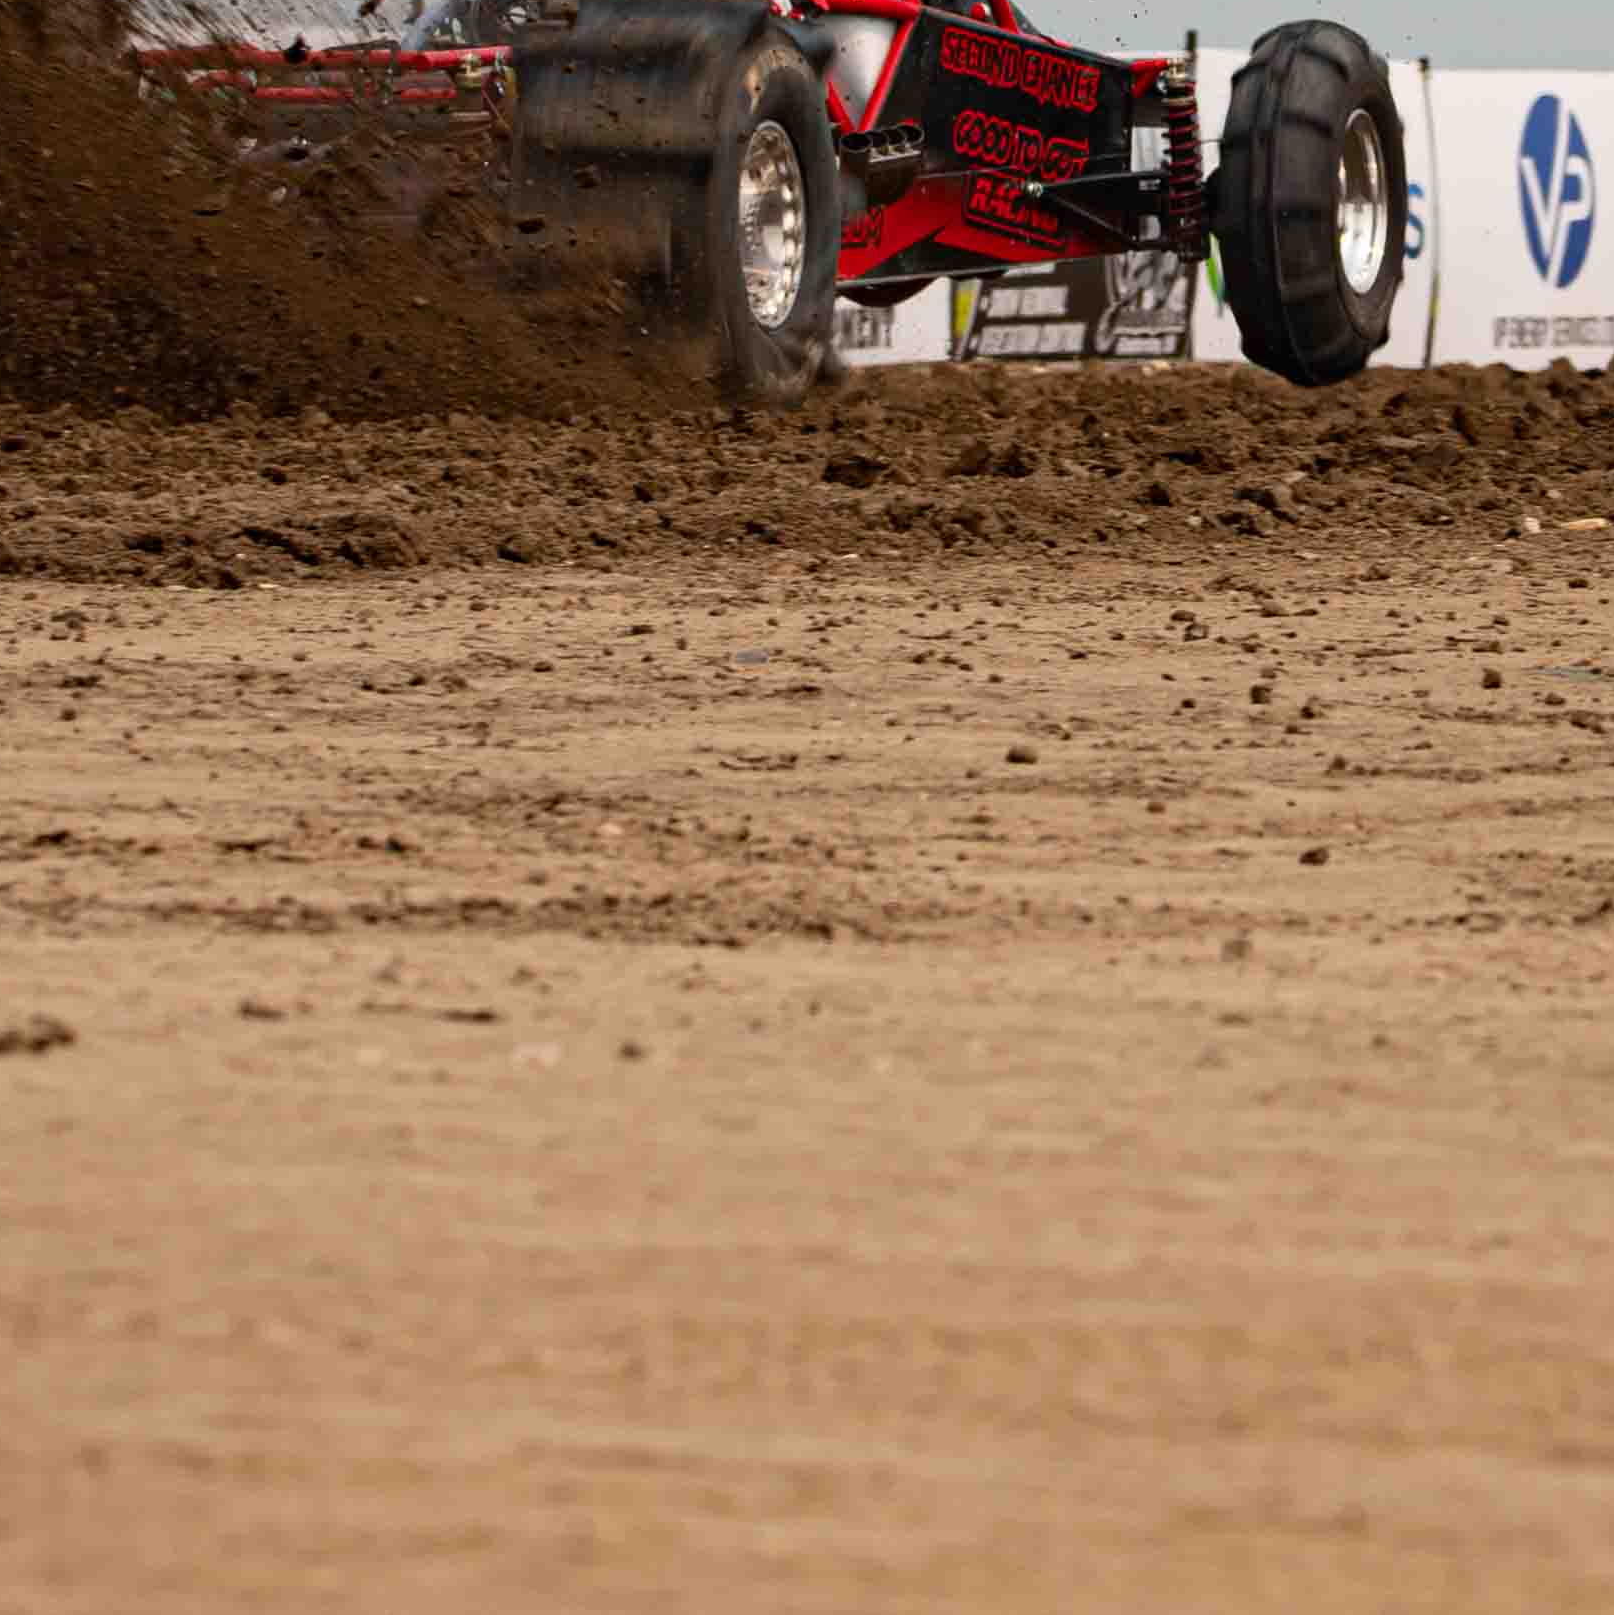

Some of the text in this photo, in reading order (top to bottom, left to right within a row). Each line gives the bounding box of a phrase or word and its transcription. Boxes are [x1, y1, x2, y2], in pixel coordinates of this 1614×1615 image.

[939, 26, 1101, 114] SECOND CHANCE
[952, 109, 1014, 166] GOOD
[1014, 124, 1043, 174] TO
[1520, 94, 1596, 288] VP
